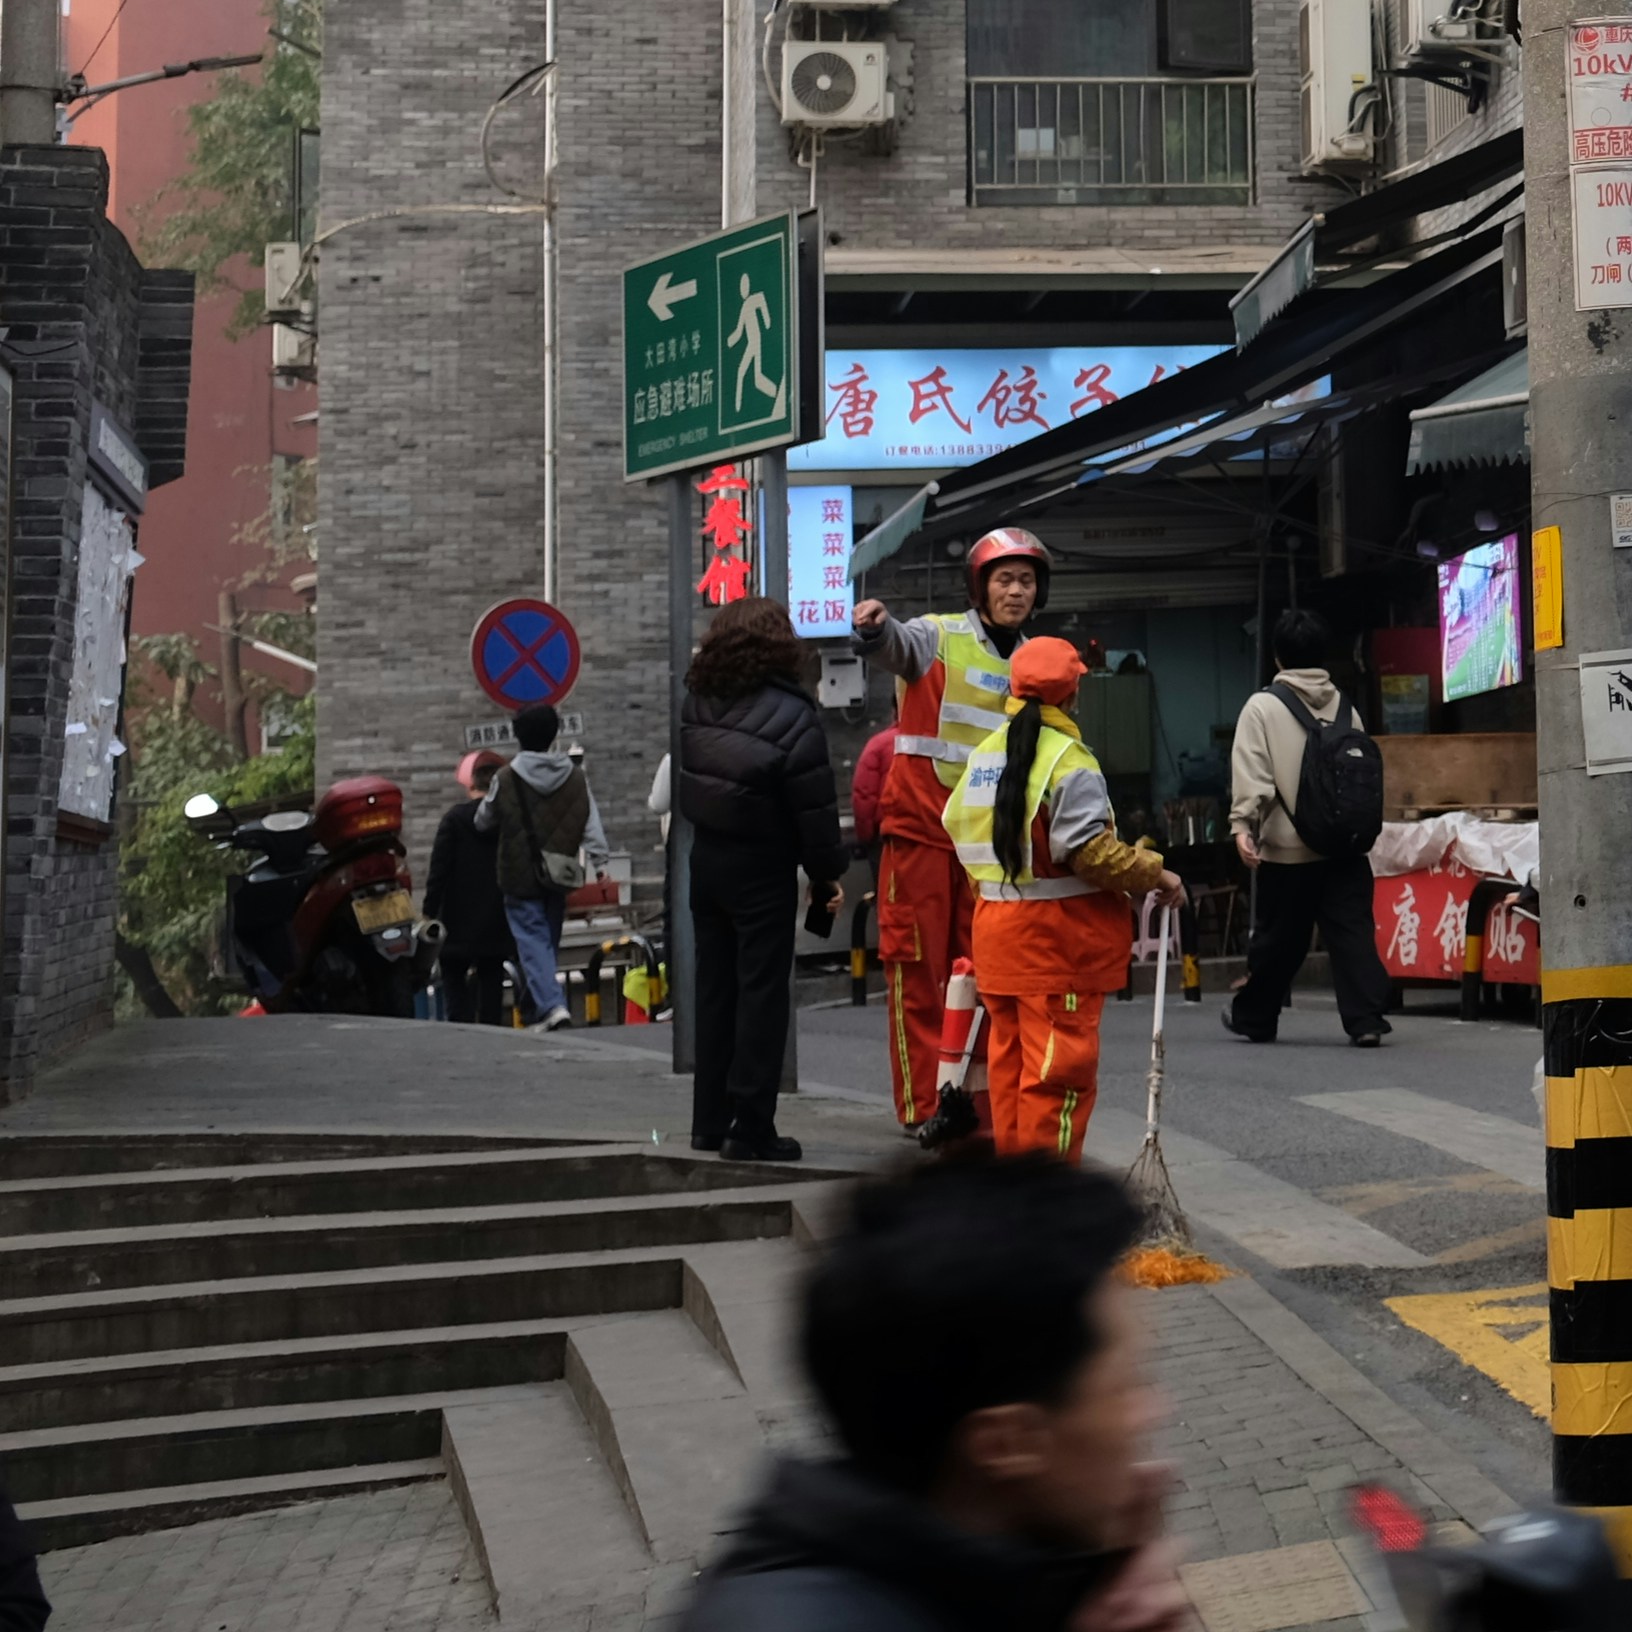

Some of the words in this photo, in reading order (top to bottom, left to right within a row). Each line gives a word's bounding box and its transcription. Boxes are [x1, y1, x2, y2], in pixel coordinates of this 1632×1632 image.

[633, 368, 714, 425] 应急避难场所
[826, 361, 1190, 440] 唐氏饺子
[980, 671, 1011, 691] 渝中
